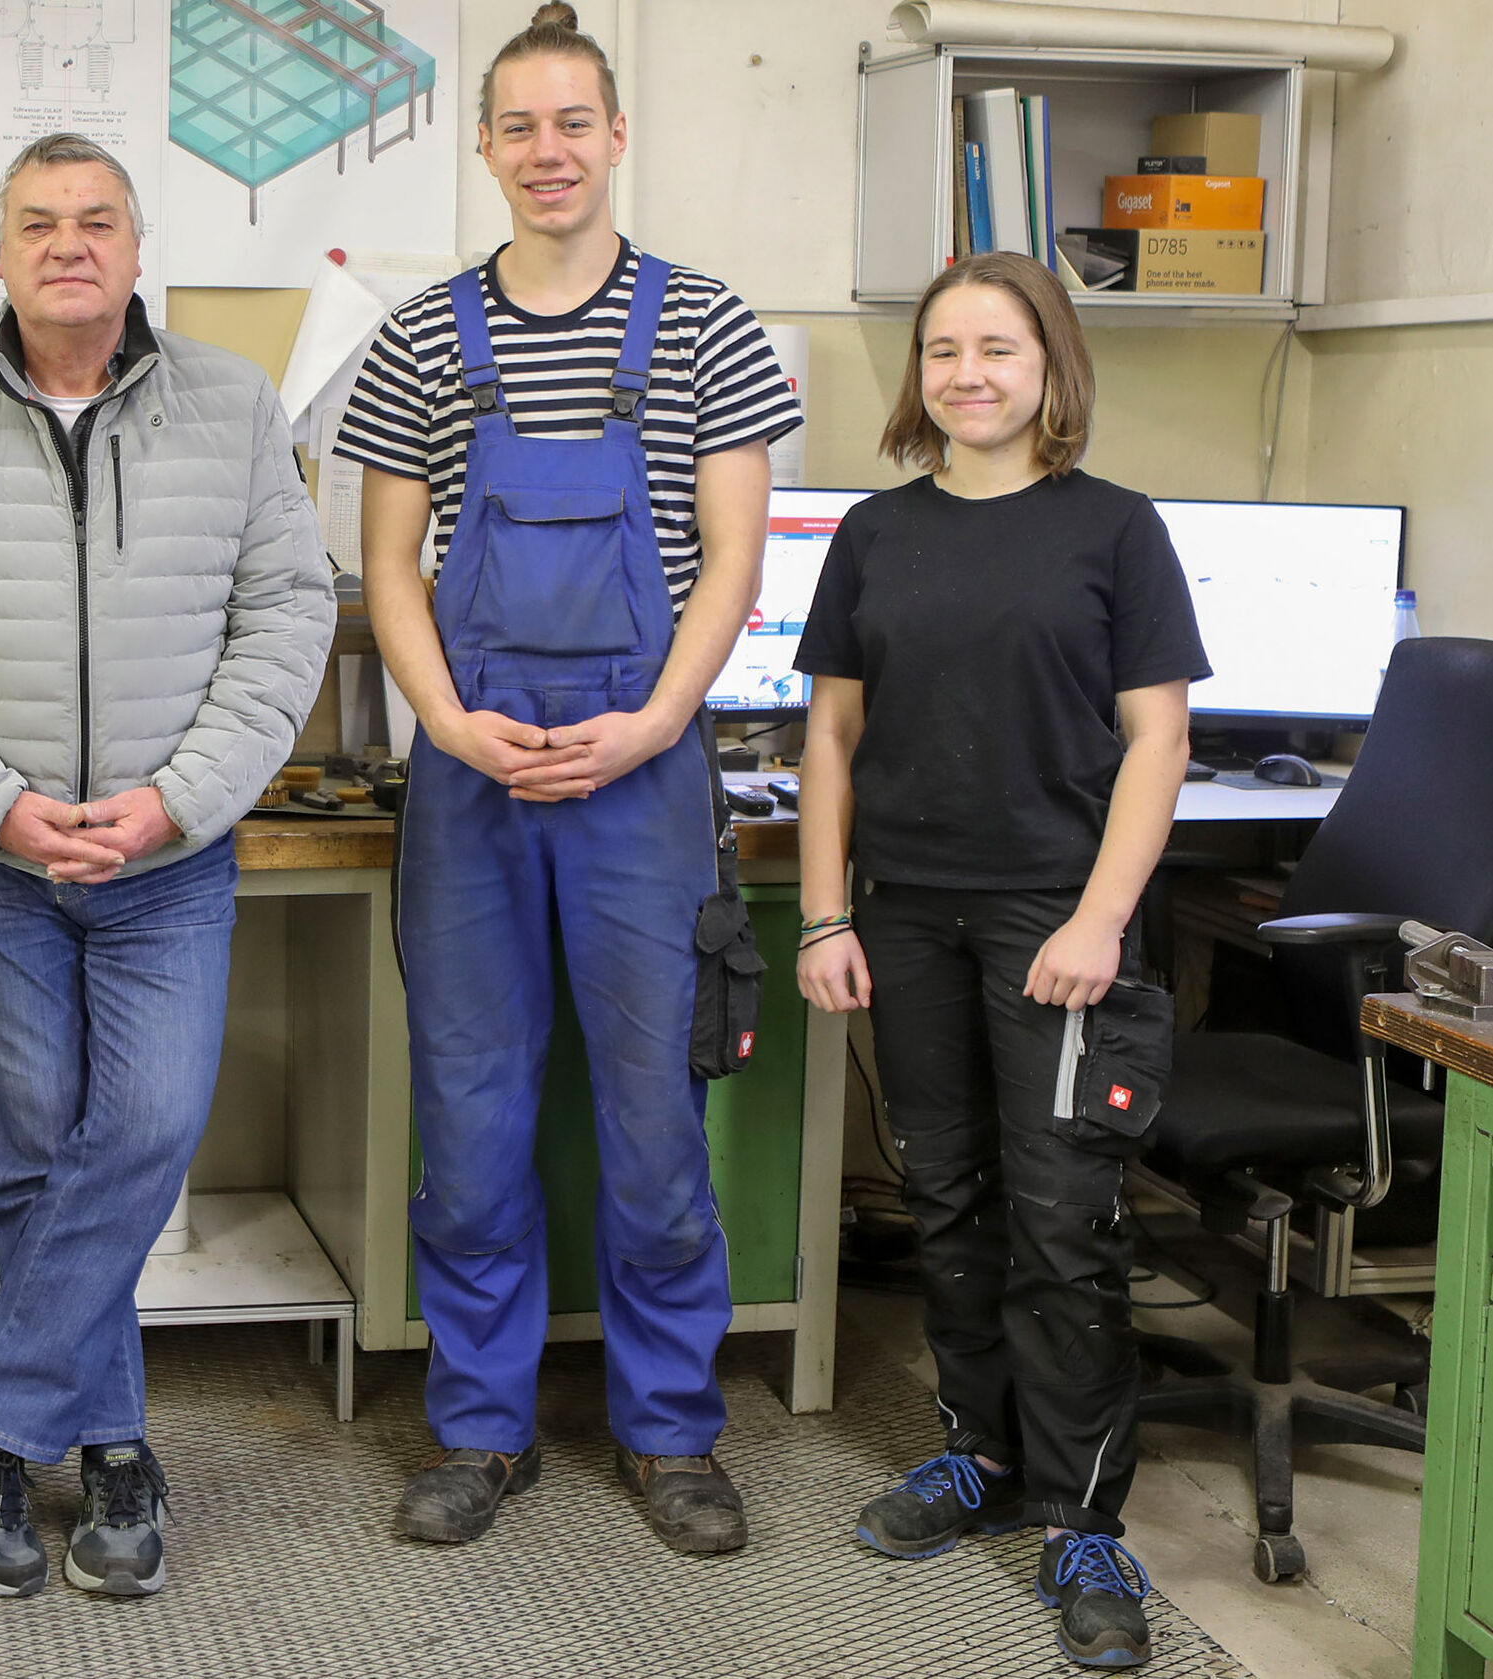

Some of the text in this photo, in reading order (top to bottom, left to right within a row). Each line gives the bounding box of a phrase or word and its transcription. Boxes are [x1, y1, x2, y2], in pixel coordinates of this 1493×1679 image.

[1117, 192, 1153, 214] Gigaset
[1147, 238, 1188, 255] D785
[1146, 270, 1161, 278] One
[1163, 270, 1171, 278] of
[1172, 270, 1185, 278] the
[1146, 280, 1173, 288] phones
